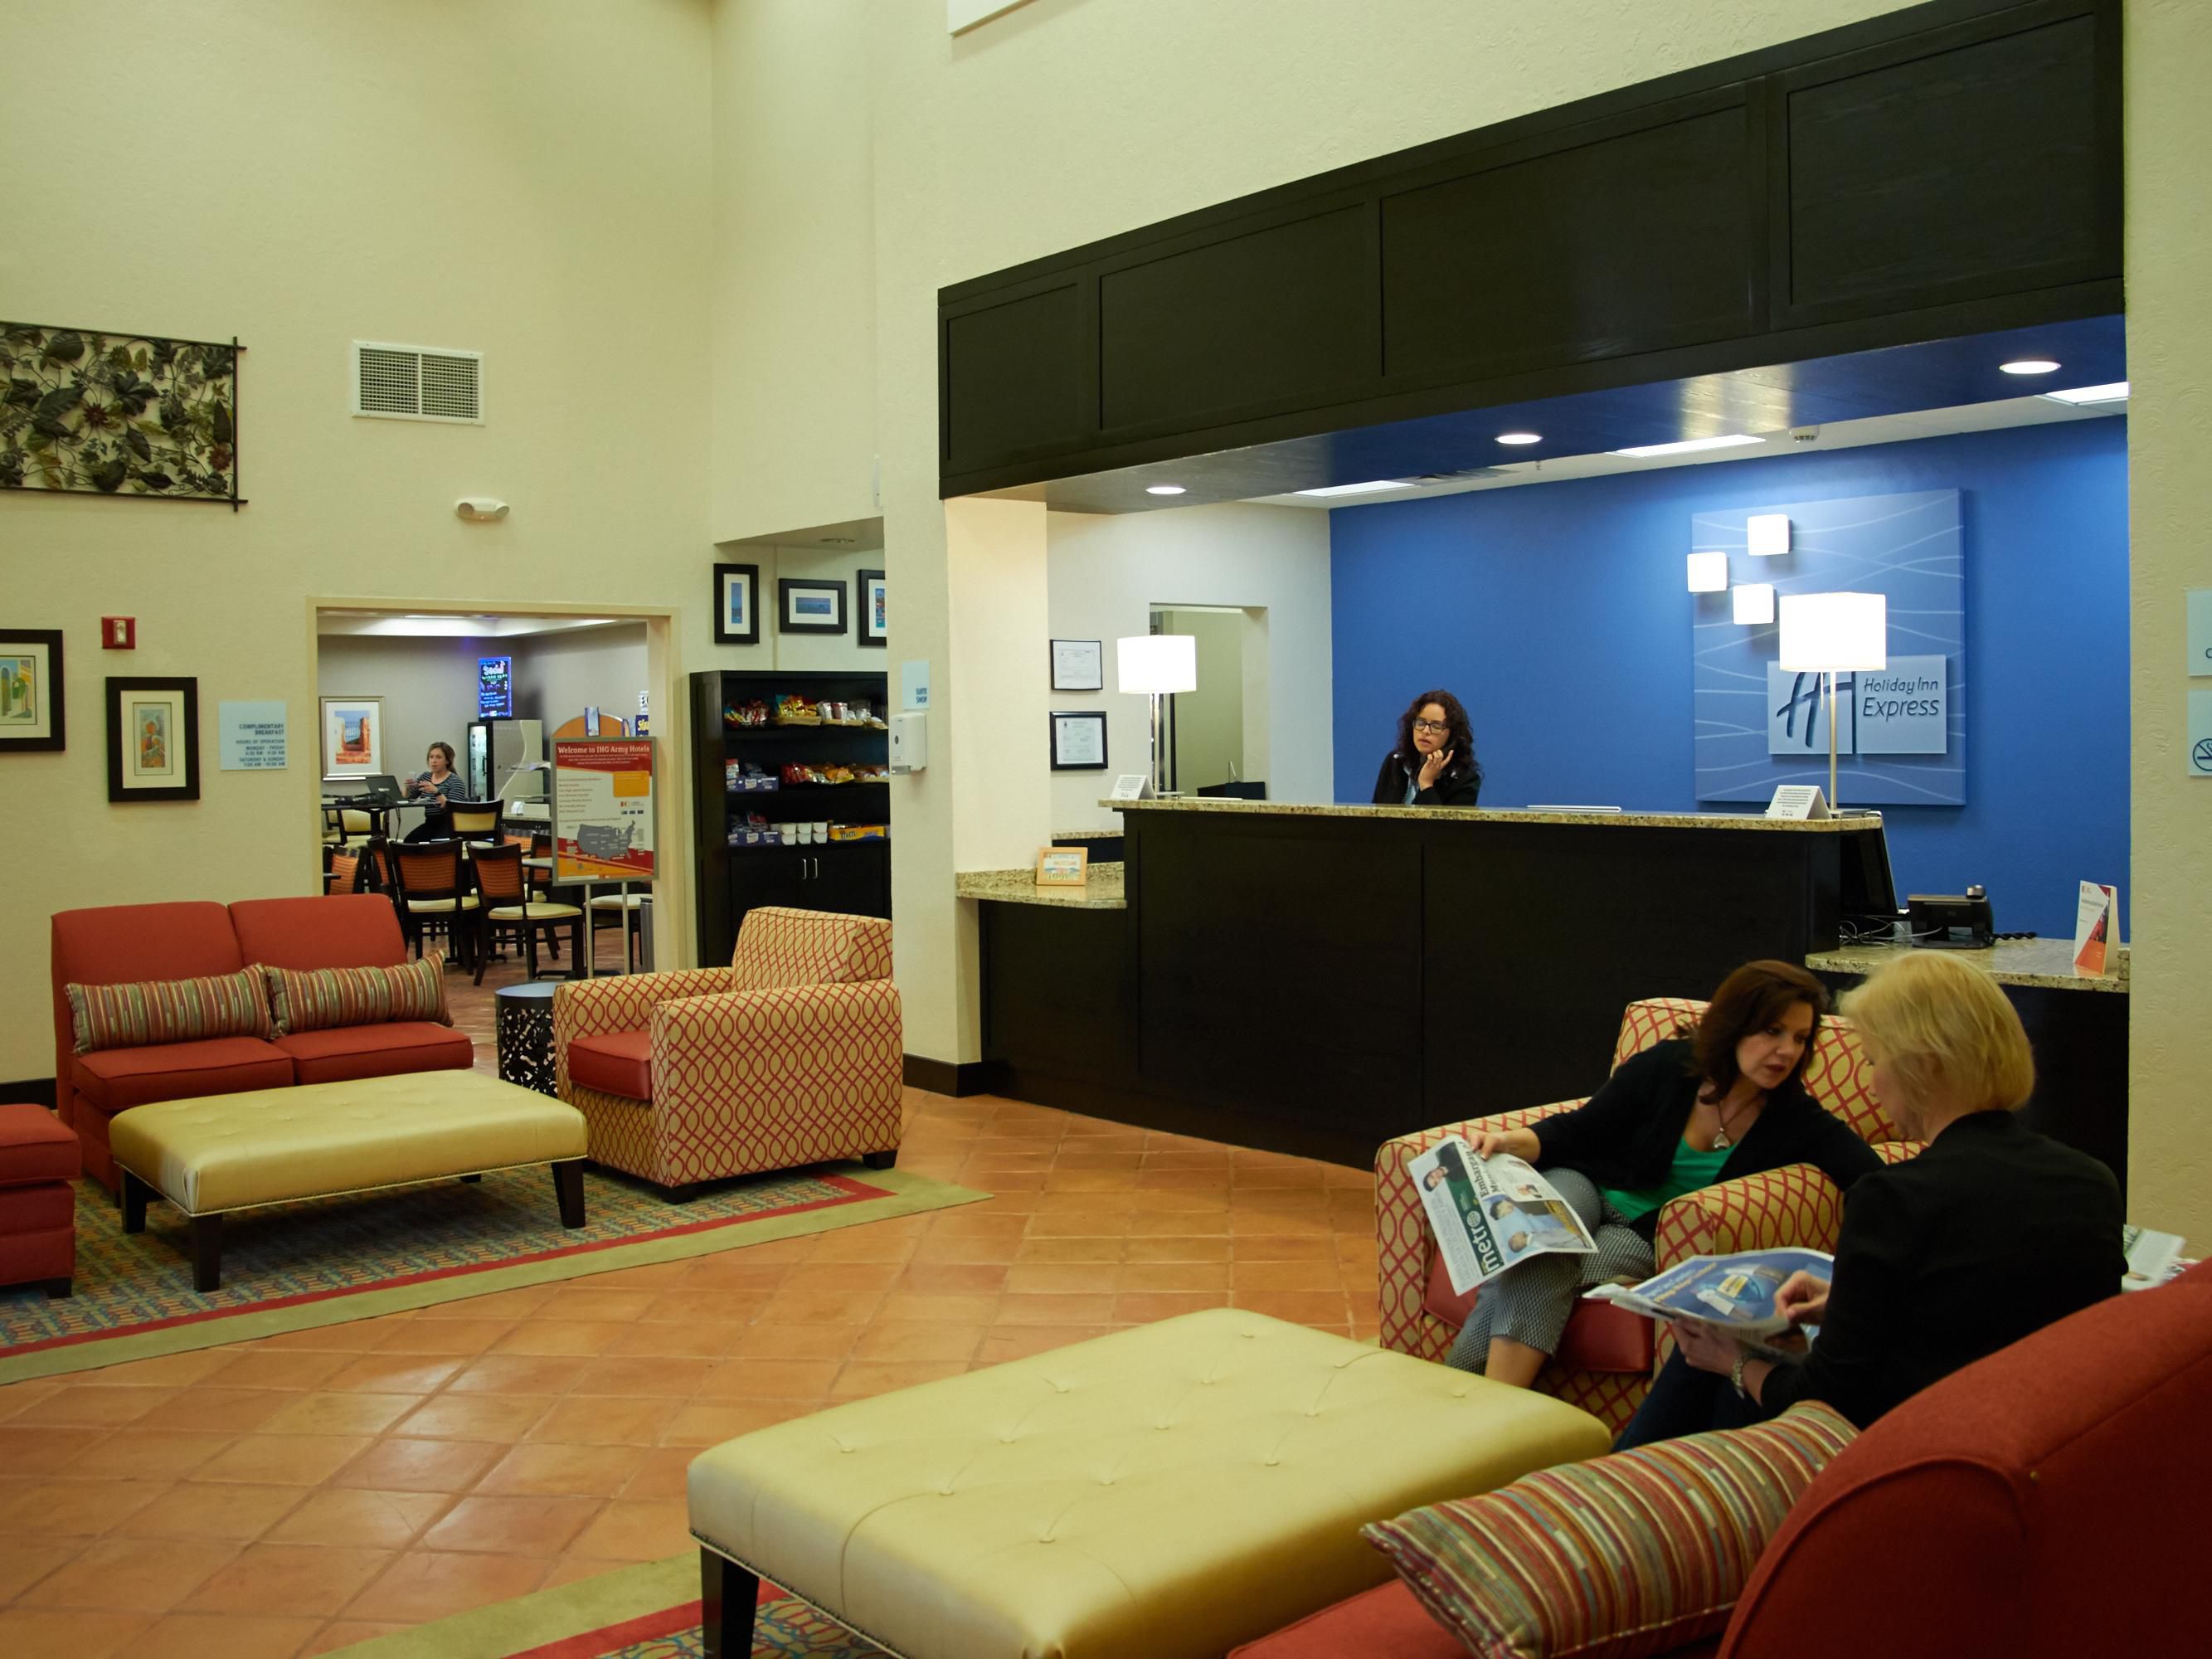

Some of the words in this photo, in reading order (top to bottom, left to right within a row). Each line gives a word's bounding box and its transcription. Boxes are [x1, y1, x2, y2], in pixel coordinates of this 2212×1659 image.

[1864, 678, 1915, 693] Holiday
[1917, 677, 1938, 691] Inn
[1863, 697, 1940, 722] Express
[610, 746, 629, 756] Army
[1466, 1210, 1500, 1272] metro
